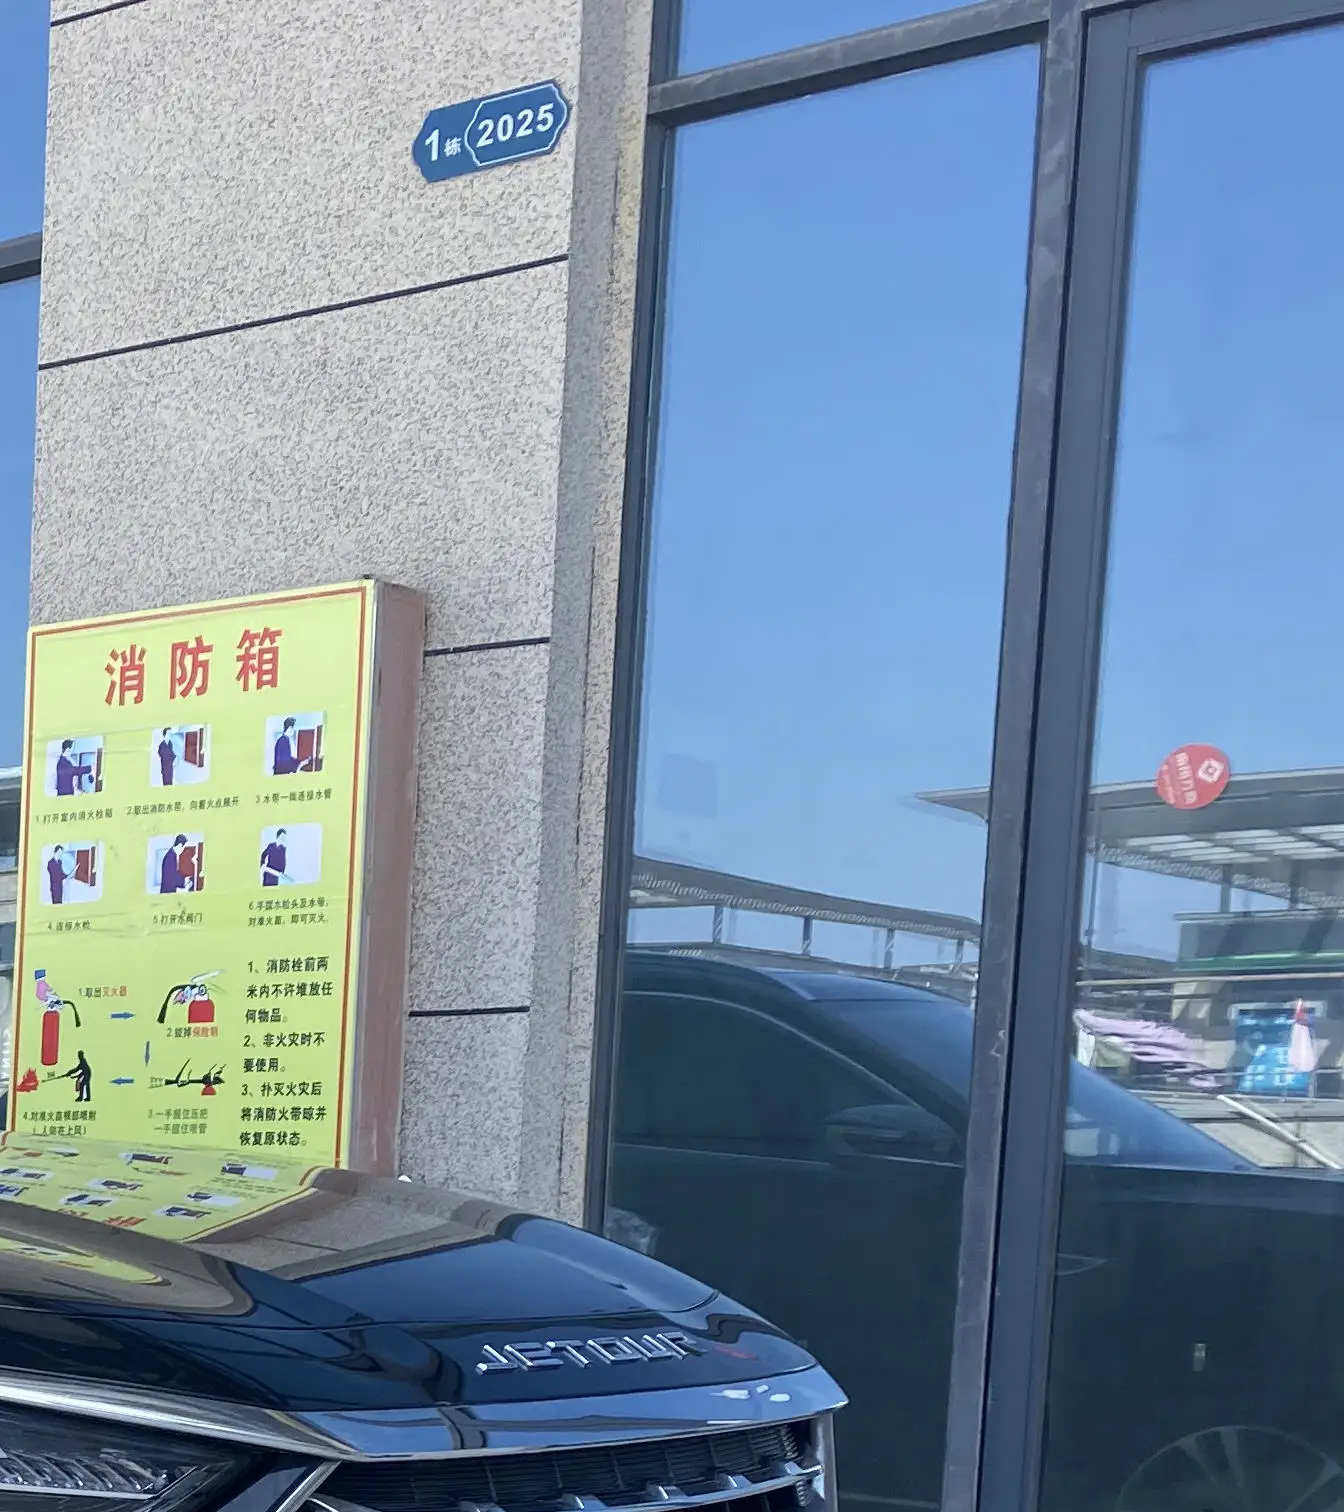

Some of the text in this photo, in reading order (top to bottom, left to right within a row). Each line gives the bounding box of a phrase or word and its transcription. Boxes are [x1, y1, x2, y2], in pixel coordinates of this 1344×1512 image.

[424, 102, 554, 161] 1栋 2025
[104, 626, 283, 706] 消防箱
[247, 955, 329, 974] 1、消防栓前两
[246, 981, 333, 999] 米内不许堆放任
[244, 1007, 288, 1024] 何物品。
[243, 1031, 326, 1049] 2、非火灾时不
[242, 1057, 286, 1074] 要使用。
[241, 1081, 323, 1098] 3、扑灭火灾后
[239, 1130, 307, 1147] 恢复原状态。
[474, 1331, 699, 1375] JETOUR
